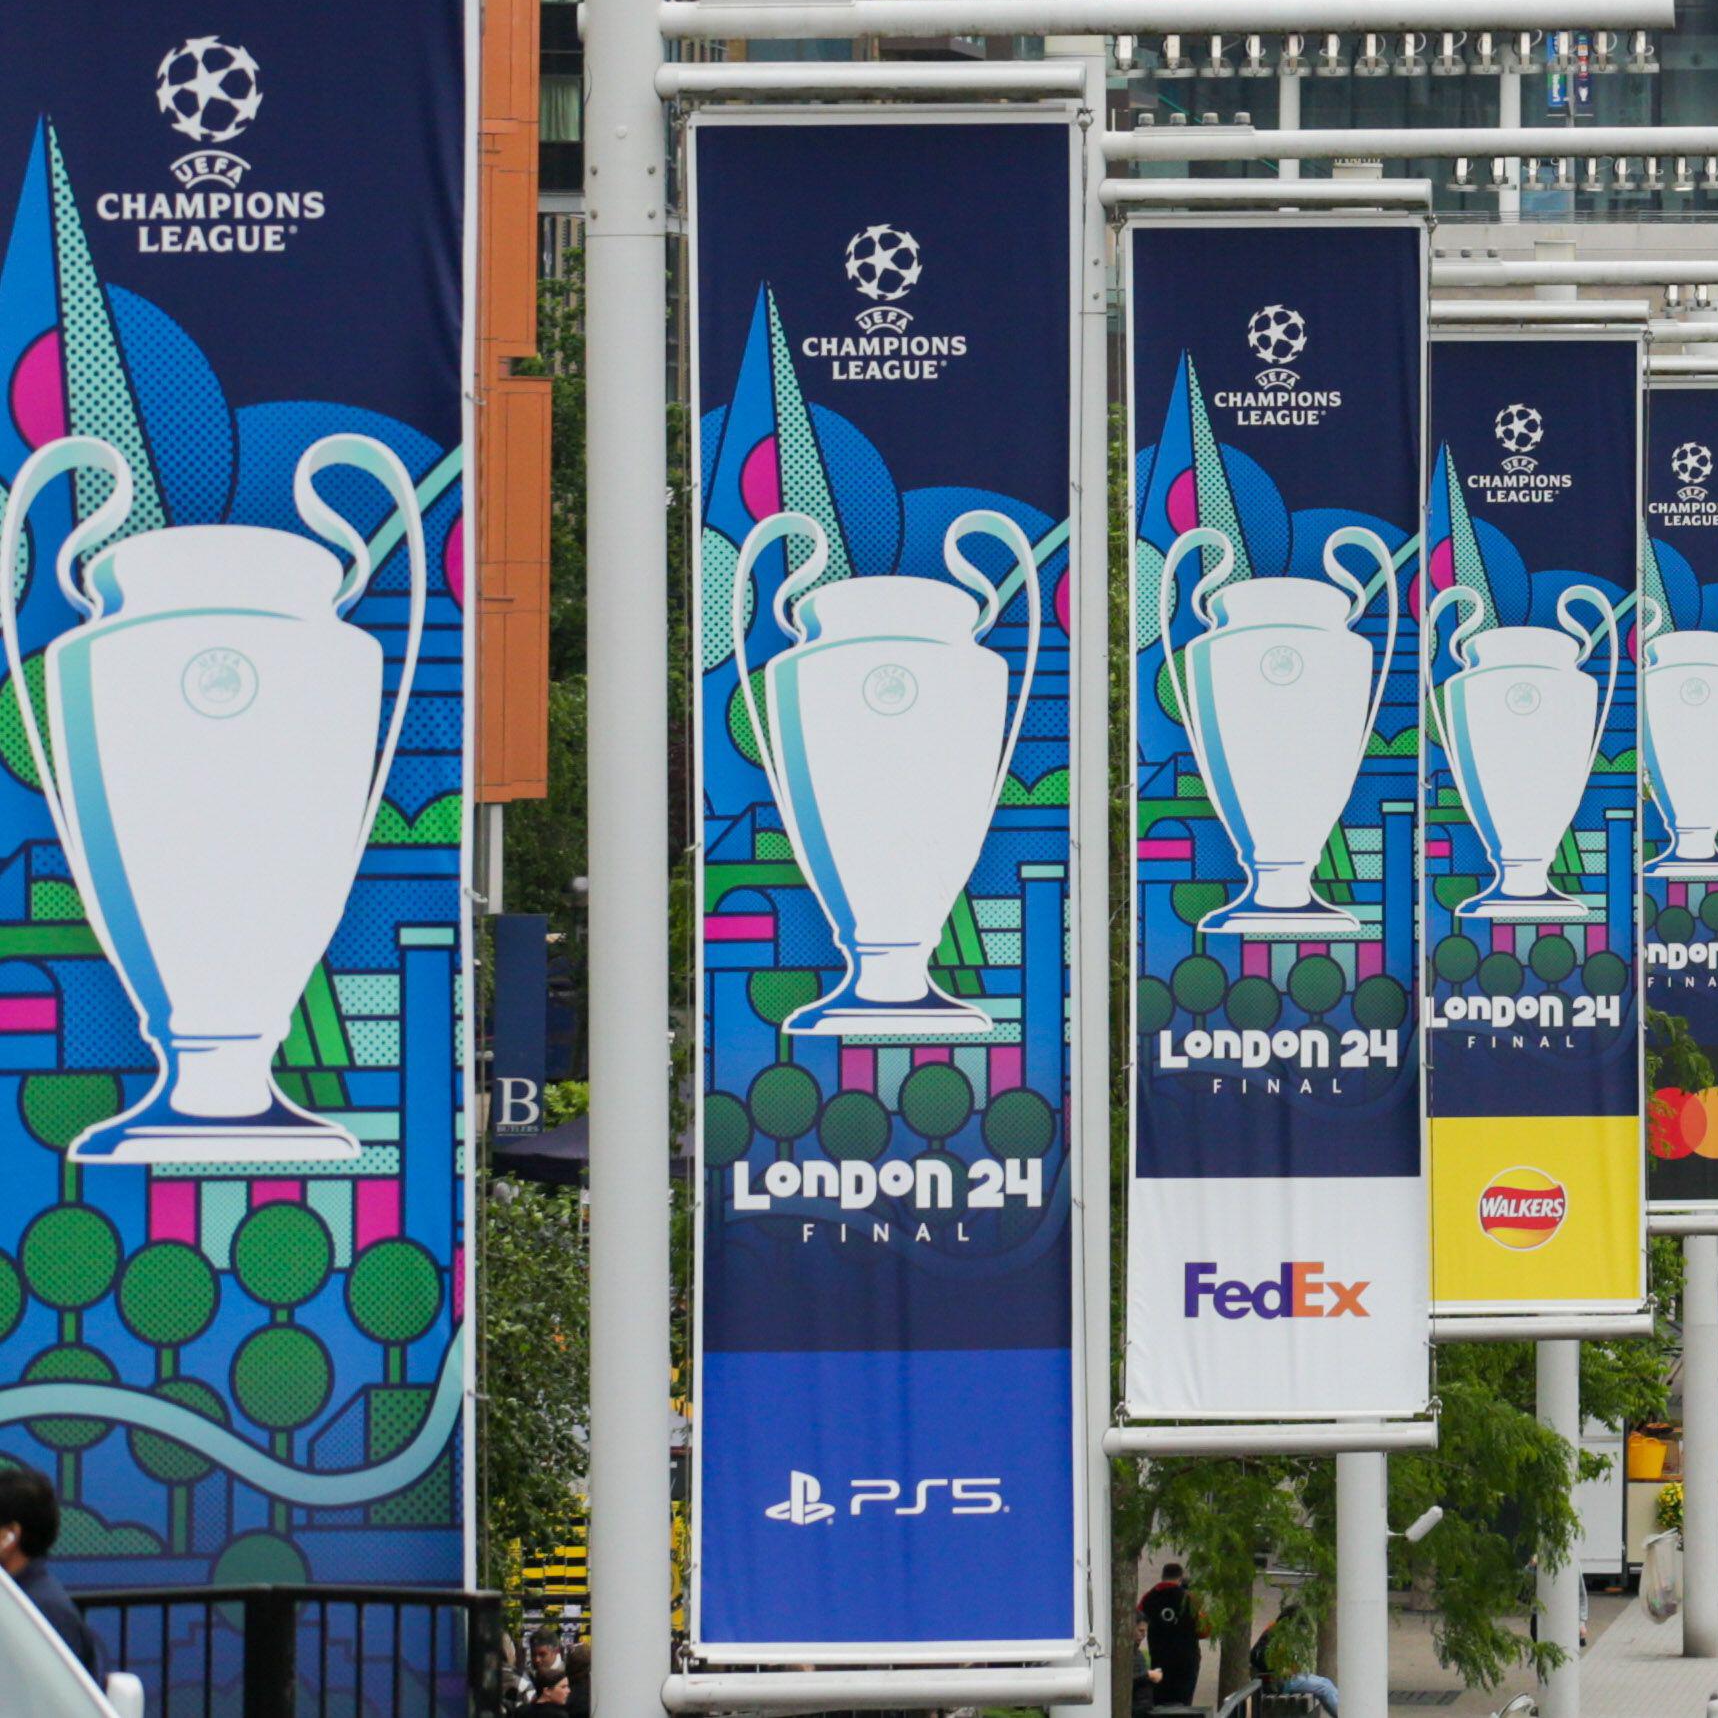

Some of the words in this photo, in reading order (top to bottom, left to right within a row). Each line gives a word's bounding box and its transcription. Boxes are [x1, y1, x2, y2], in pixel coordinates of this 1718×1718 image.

[174, 155, 243, 184] UEFA
[97, 191, 325, 220] CHAMPIONS
[139, 225, 286, 253] LEAGUE
[857, 309, 911, 332] UEFA
[802, 335, 967, 359] CHAMPIONS
[831, 359, 939, 381] LEAGUE
[1257, 369, 1297, 388] UEFA
[1214, 391, 1342, 408] CHAMPIONS
[1236, 408, 1320, 426] LEAGUE
[1468, 475, 1572, 489] CHAMPIONS
[1486, 489, 1554, 503] LEAGUE
[1573, 995, 1620, 1028] 24
[1341, 1029, 1398, 1068] 24
[1468, 1036, 1574, 1049] FINAL
[1212, 1078, 1342, 1094] FINAL
[496, 1077, 540, 1125] B
[967, 1158, 1043, 1210] 24
[1480, 1196, 1564, 1220] WALKERS
[802, 1222, 970, 1243] FINAL
[1184, 1261, 1371, 1319] FedEx
[850, 1477, 1002, 1516] PS5
